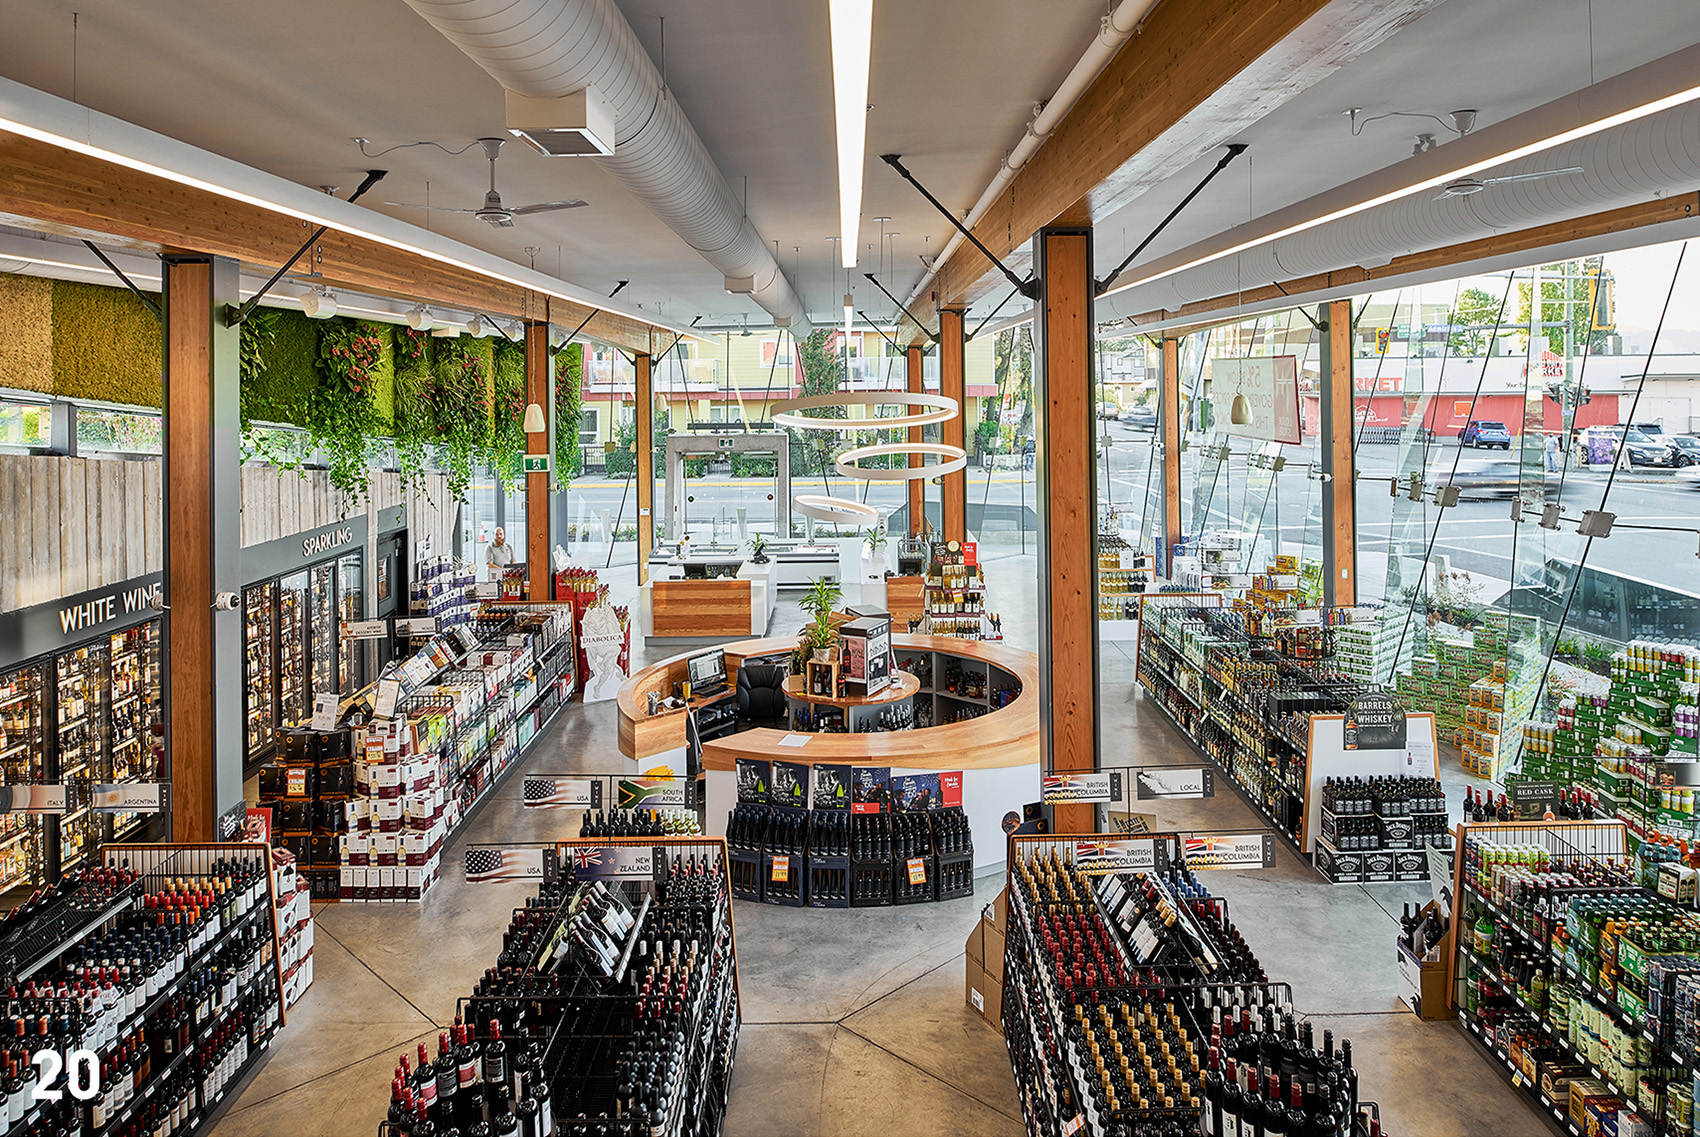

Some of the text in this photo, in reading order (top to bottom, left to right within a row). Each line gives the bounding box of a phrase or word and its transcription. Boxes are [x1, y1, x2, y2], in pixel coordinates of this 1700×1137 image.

[1354, 377, 1403, 391] RKET
[303, 527, 352, 557] SPARKLING
[60, 595, 116, 635] WHITE
[582, 634, 623, 644] DIABOLICA
[1358, 701, 1392, 709] BARRELS
[1358, 714, 1393, 723] WHISKEY
[1234, 844, 1260, 852] BRITISH
[1115, 857, 1152, 866] COLUMBIA
[1222, 853, 1261, 861] COLUMBIA
